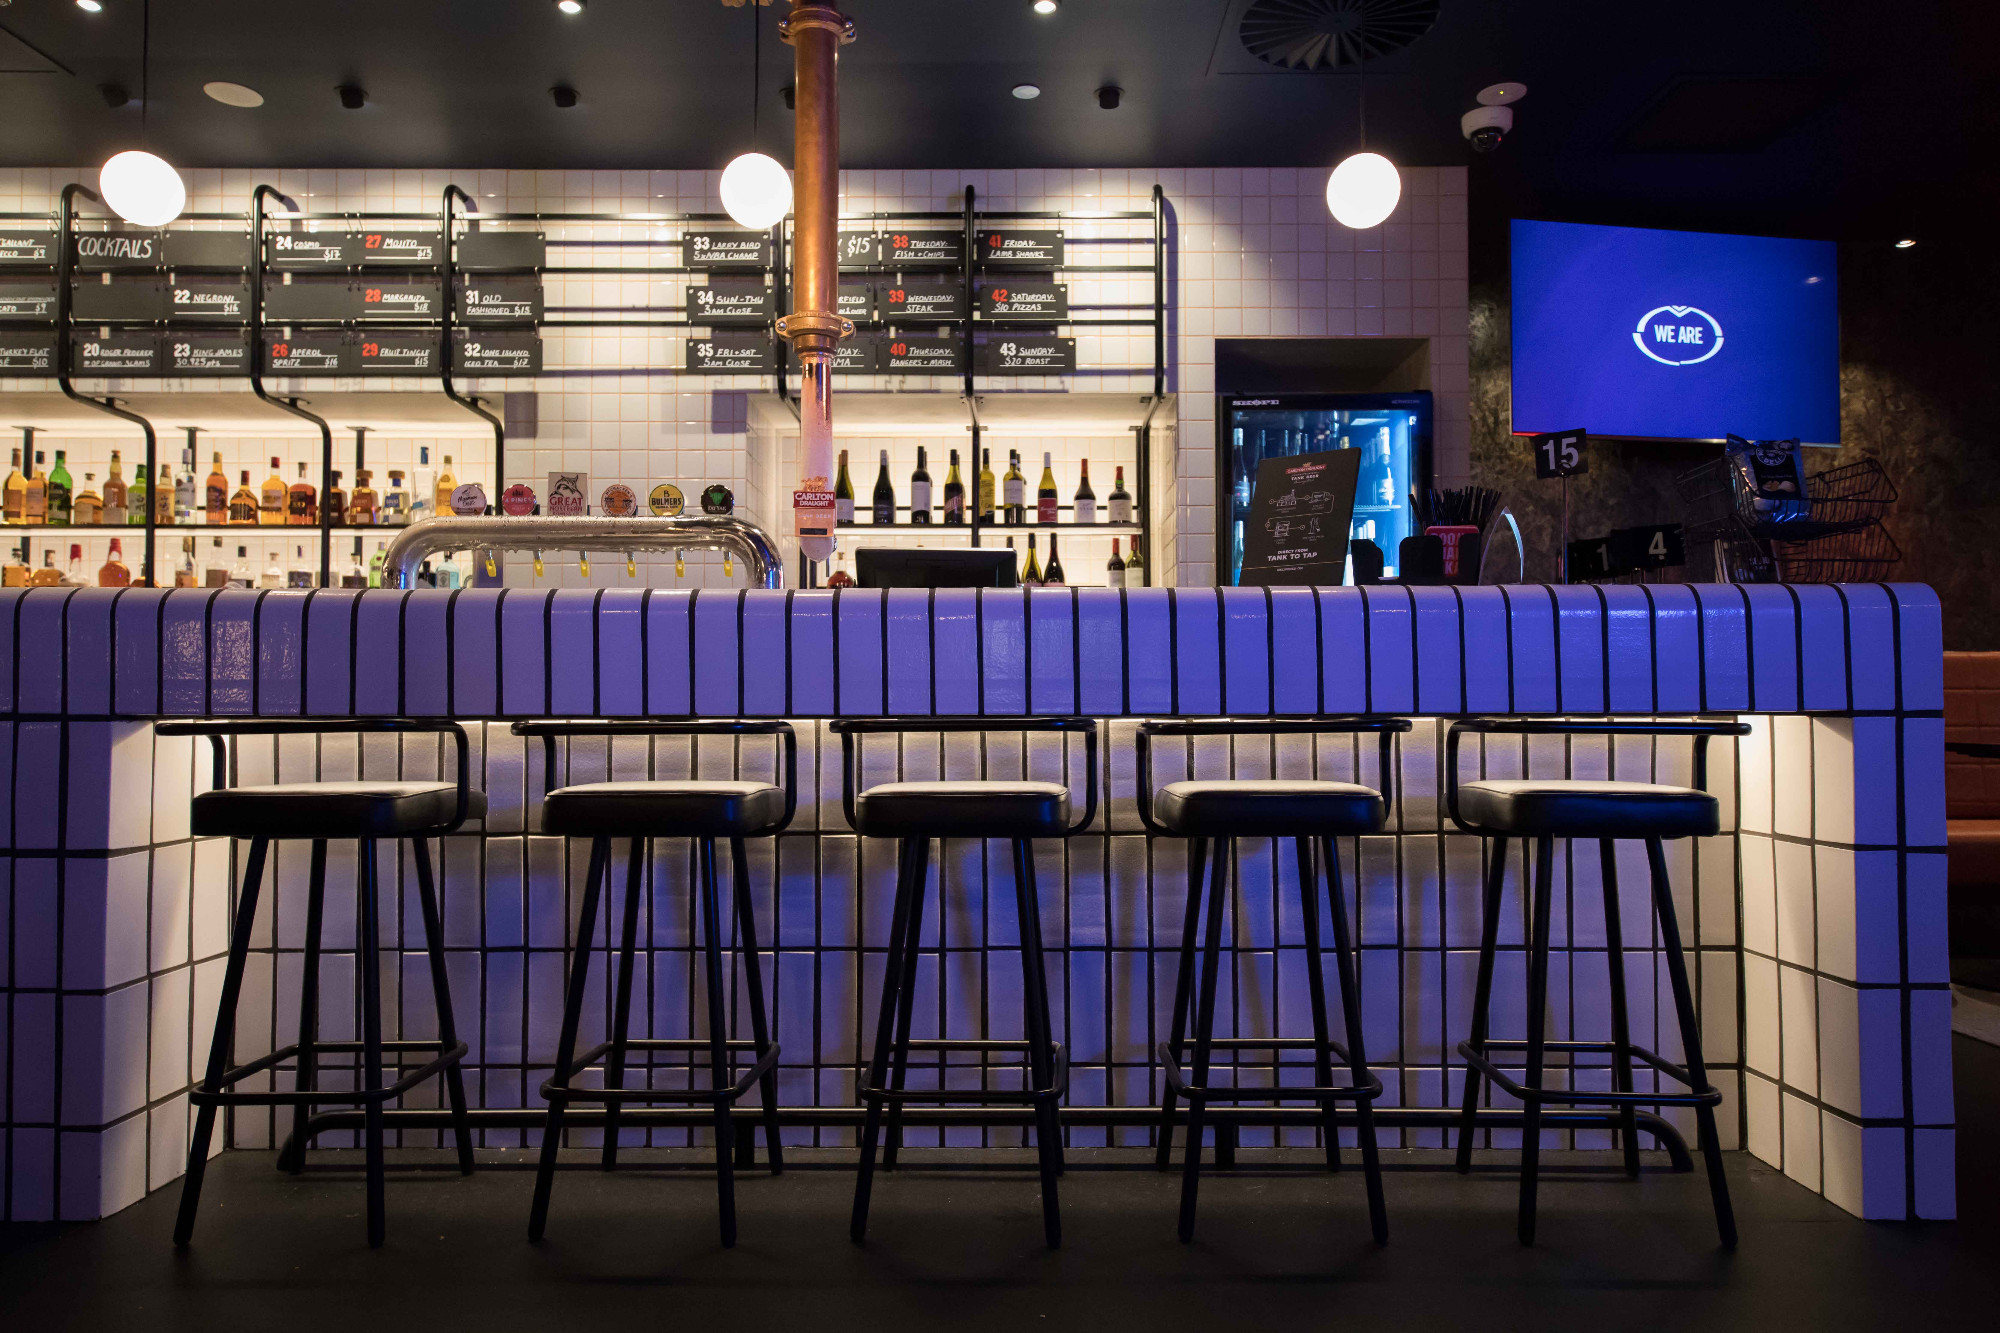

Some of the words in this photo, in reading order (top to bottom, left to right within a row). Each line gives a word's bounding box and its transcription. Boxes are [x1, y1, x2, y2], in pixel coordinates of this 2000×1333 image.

[77, 236, 153, 259] COCKTAILS
[276, 235, 293, 250] 24
[293, 240, 320, 249] COSMO
[365, 234, 382, 249] 27
[384, 238, 418, 248] MOJITO
[693, 236, 710, 251] 33
[711, 241, 738, 250] LARRY
[740, 241, 762, 250] BIRD
[847, 234, 871, 258] $15
[892, 234, 909, 249] 38
[988, 234, 1002, 248] 41
[34, 248, 46, 260] $9
[323, 248, 342, 262] $17
[417, 248, 433, 261] $15
[727, 251, 759, 260] CHAMP
[990, 249, 1013, 258] LAMB
[173, 289, 191, 303] 22
[193, 294, 235, 303] NEGRONI
[364, 288, 382, 303] 28
[383, 293, 425, 302] MARGARITA
[465, 290, 479, 305] 31
[482, 294, 502, 303] OLD
[697, 290, 714, 305] 34
[838, 295, 866, 304] RFIELD
[888, 288, 905, 304] 39
[991, 288, 1008, 303] 42
[35, 302, 47, 315] $9
[223, 302, 239, 315] $16
[414, 301, 429, 313] $18
[467, 305, 510, 315] FASHIONED
[514, 303, 531, 317] $15
[726, 306, 754, 315] CLOSE
[905, 304, 934, 313] STEAK
[994, 301, 1010, 312] $10
[1011, 303, 1042, 311] PIZZAS
[1653, 324, 1676, 344] WE
[1677, 325, 1704, 345] ARE
[28, 347, 50, 356] FLAT
[83, 343, 100, 357] 20
[173, 343, 191, 358] 23
[193, 348, 214, 357] KING
[215, 348, 244, 358] JAMES
[272, 343, 289, 358] 26
[291, 348, 322, 357] APEROL
[361, 342, 379, 357] 29
[380, 347, 401, 357] FRUIT
[401, 348, 431, 357] TINGLE
[464, 342, 481, 357] 32
[481, 349, 500, 357] LONG
[501, 349, 529, 357] ISLAND
[697, 342, 714, 357] 35
[890, 342, 906, 357] 40
[999, 342, 1016, 357] 43
[31, 355, 48, 369] $10
[124, 359, 151, 367] SLAMS
[273, 358, 301, 367] SPRITZ
[324, 356, 339, 369] $16
[414, 356, 429, 368] $15
[464, 360, 481, 368] ICED
[483, 359, 499, 367] TEA
[512, 356, 529, 369] $17
[725, 358, 751, 367] CLOSE
[890, 358, 922, 367] BANGERS
[929, 358, 952, 367] MASH
[1004, 355, 1022, 367] $20
[1024, 357, 1051, 366] ROAST
[1542, 436, 1580, 471] 15
[549, 496, 583, 506] GREAT
[663, 490, 670, 498] B
[795, 492, 834, 500] CARLTON
[651, 497, 682, 506] BULMERS
[1648, 531, 1668, 561] 4
[1267, 554, 1288, 562] TANK
[1289, 552, 1301, 560] TO
[1302, 551, 1318, 559] TAP
